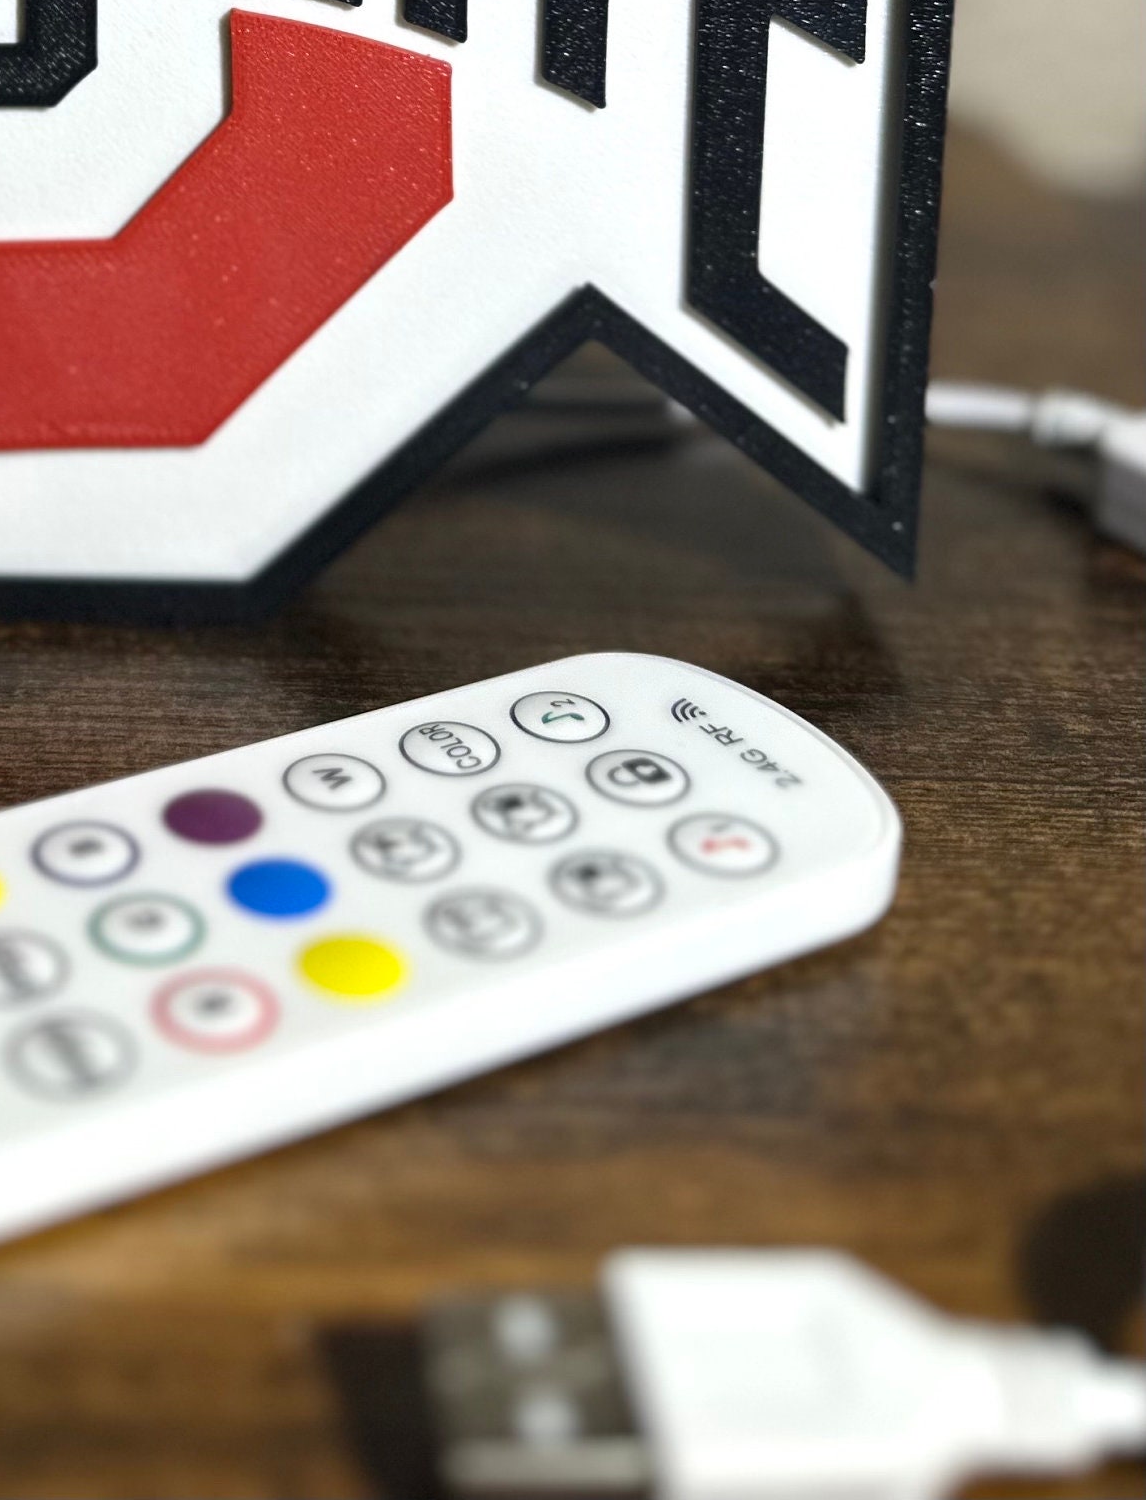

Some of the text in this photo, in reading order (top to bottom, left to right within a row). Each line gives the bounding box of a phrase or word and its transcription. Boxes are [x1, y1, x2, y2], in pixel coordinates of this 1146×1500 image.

[418, 723, 482, 770] COLOR
[698, 723, 802, 789] 2.4G RF
[311, 766, 352, 790] W
